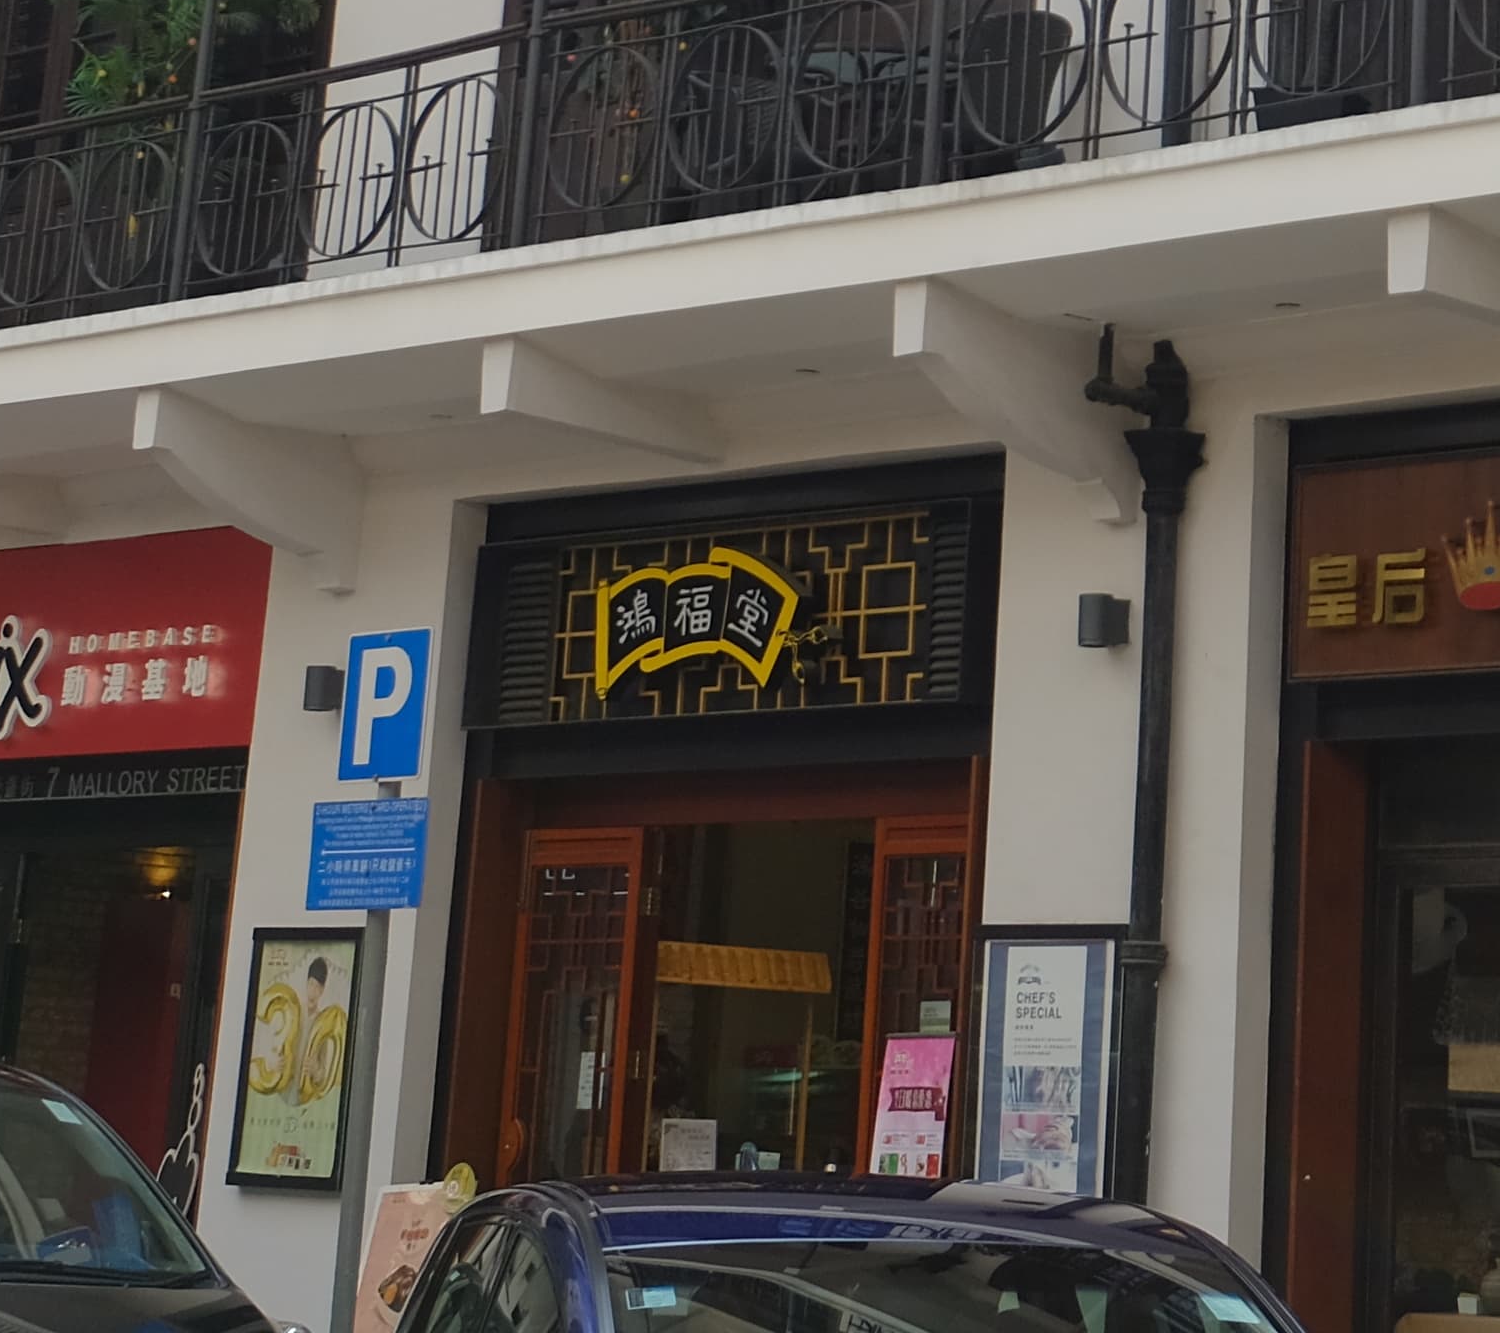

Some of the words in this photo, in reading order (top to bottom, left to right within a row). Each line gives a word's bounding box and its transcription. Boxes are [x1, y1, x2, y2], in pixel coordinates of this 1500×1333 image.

[1307, 548, 1426, 629] 皇后
[616, 585, 769, 648] 鴻福堂
[68, 624, 214, 654] HOMEBASE
[60, 656, 209, 708] 動漫基地
[353, 646, 412, 765] P
[46, 766, 61, 798] 7
[68, 769, 160, 798] MALLORY
[166, 765, 246, 794] STREET
[1015, 1007, 1062, 1019] SPECIAL
[1016, 992, 1056, 1004] CHEF'S
